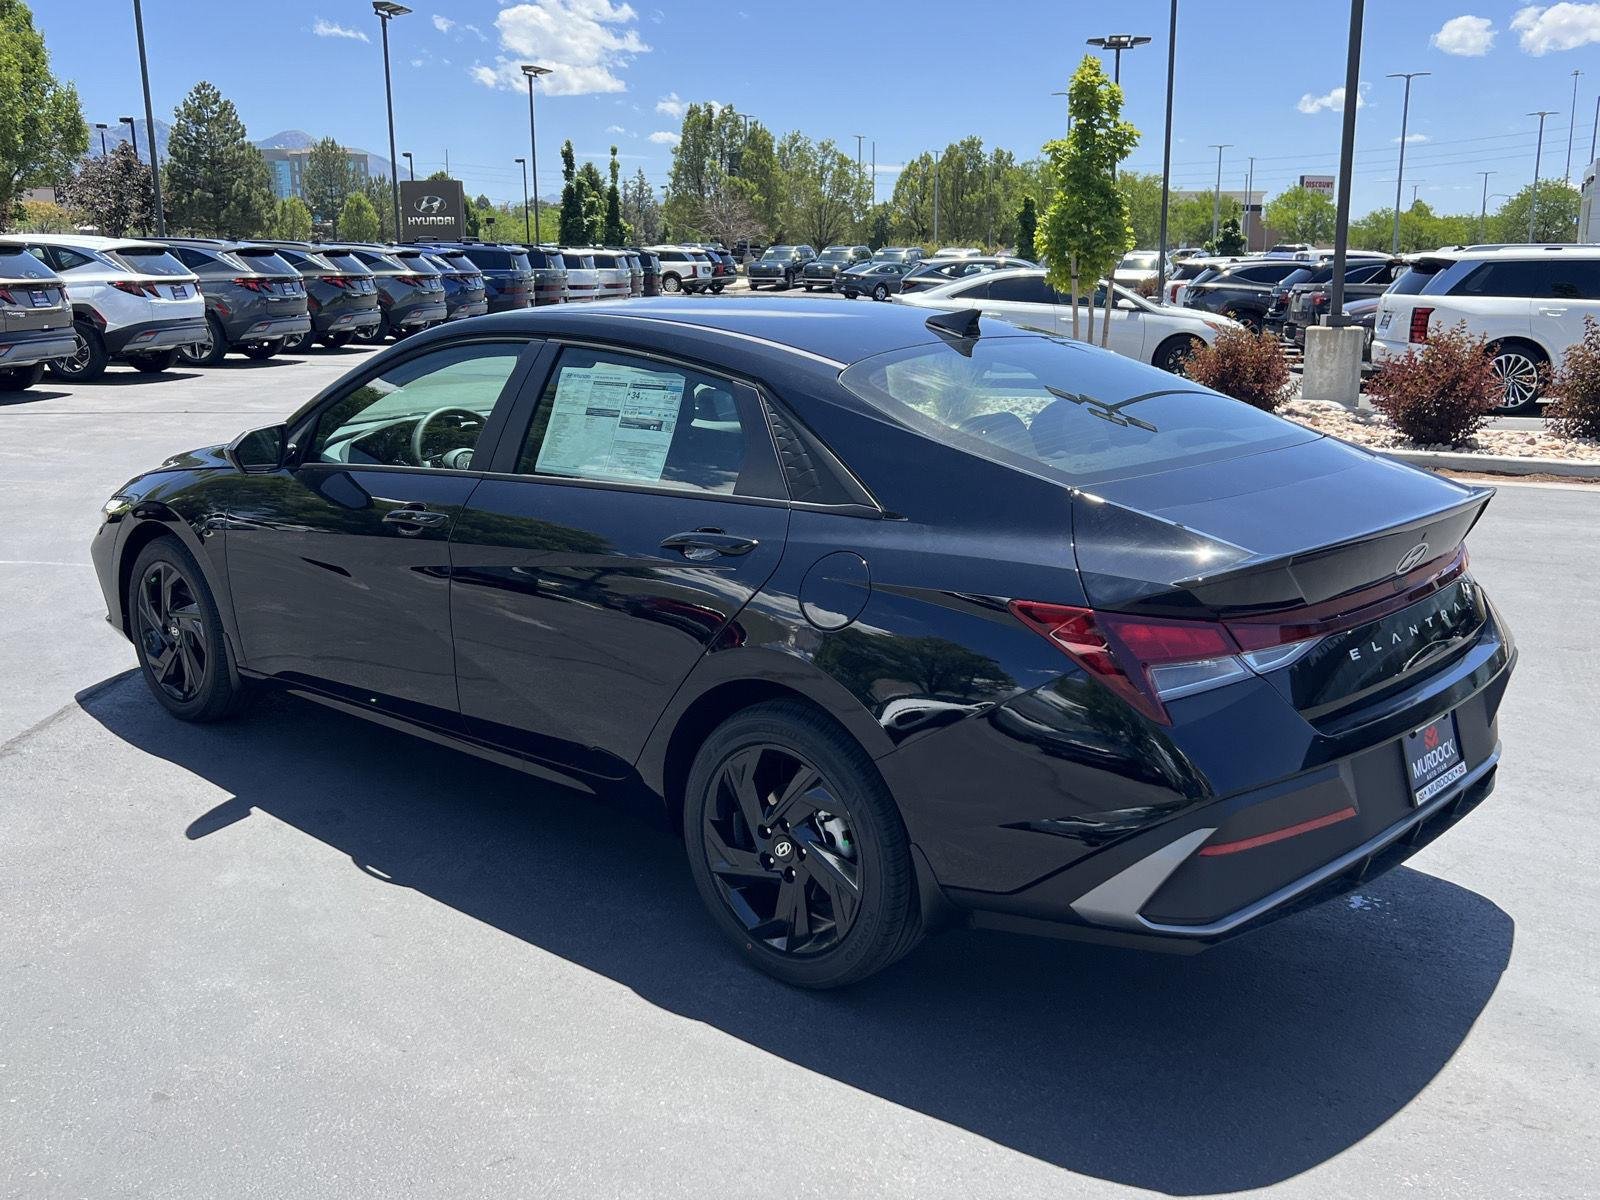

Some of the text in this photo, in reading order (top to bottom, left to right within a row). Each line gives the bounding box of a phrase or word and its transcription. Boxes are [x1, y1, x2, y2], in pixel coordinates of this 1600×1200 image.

[1305, 180, 1334, 188] DISCOUNT
[407, 216, 455, 226] HYUNDAI
[630, 391, 640, 399] 34
[1349, 602, 1461, 661] ELANTRA
[1412, 738, 1455, 779] MURDOCK
